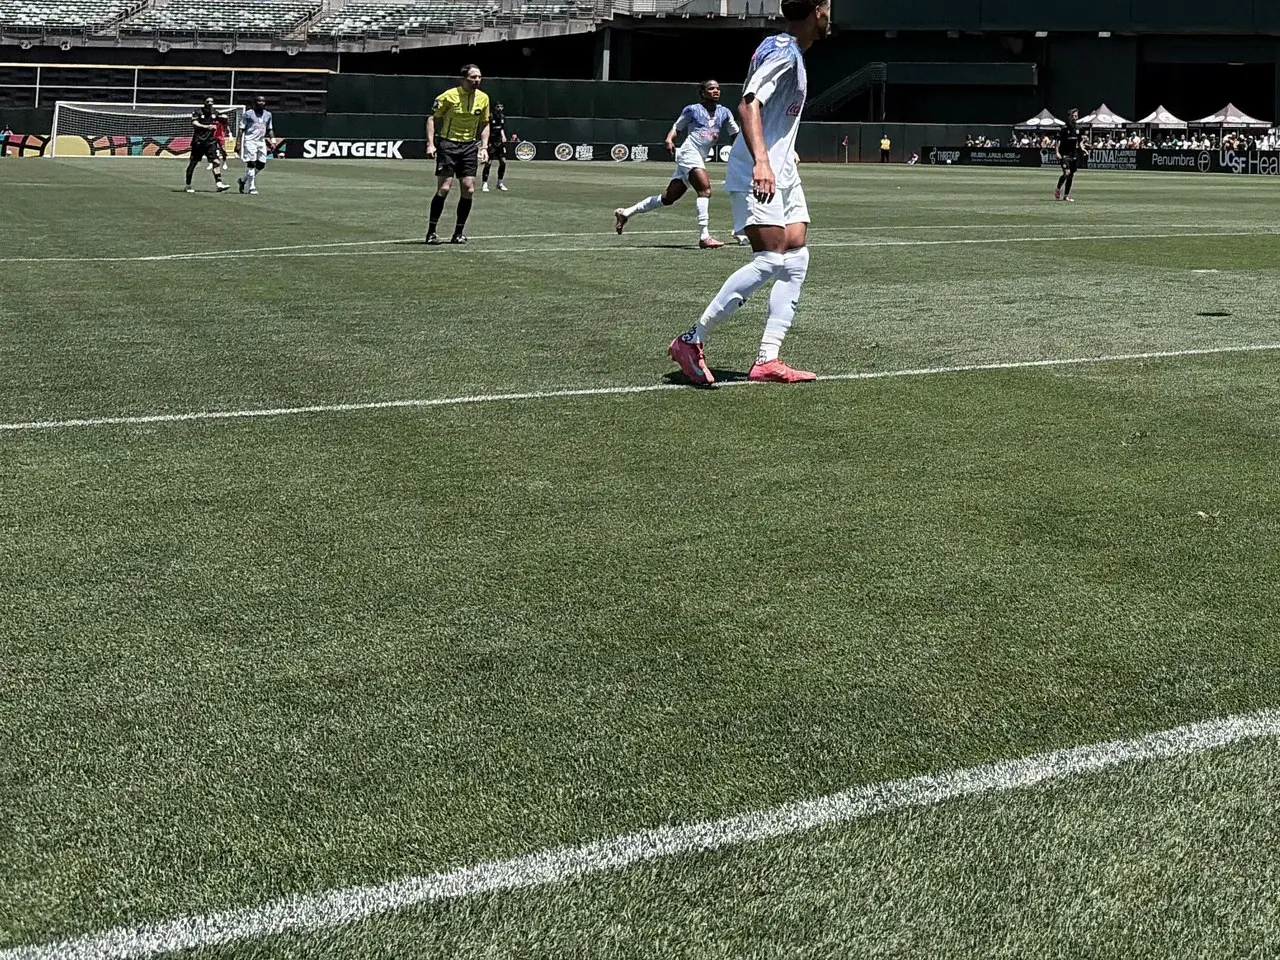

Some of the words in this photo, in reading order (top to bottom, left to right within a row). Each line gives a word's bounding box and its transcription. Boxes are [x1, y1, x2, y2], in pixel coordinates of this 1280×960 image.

[302, 139, 404, 160] SEATGEEK
[1151, 153, 1195, 167] Penumbra
[1219, 150, 1247, 174] UCSF
